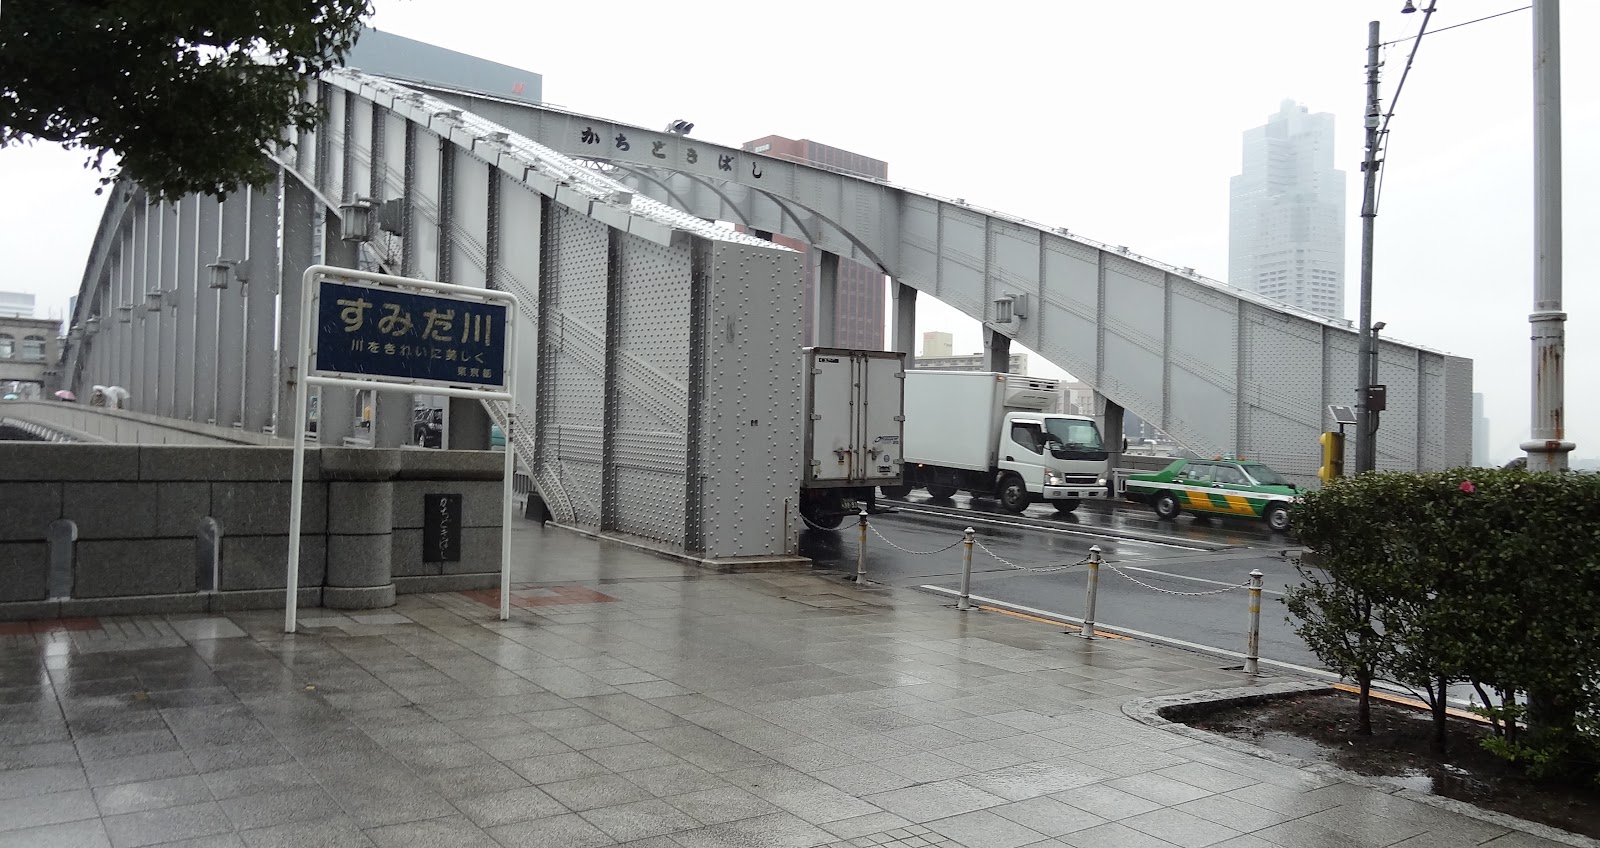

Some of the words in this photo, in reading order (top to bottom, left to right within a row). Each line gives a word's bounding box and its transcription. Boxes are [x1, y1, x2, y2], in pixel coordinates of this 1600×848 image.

[337, 297, 492, 347] すみだ川
[351, 338, 484, 364] 川をきれいに美しく
[456, 366, 492, 379] 東京都
